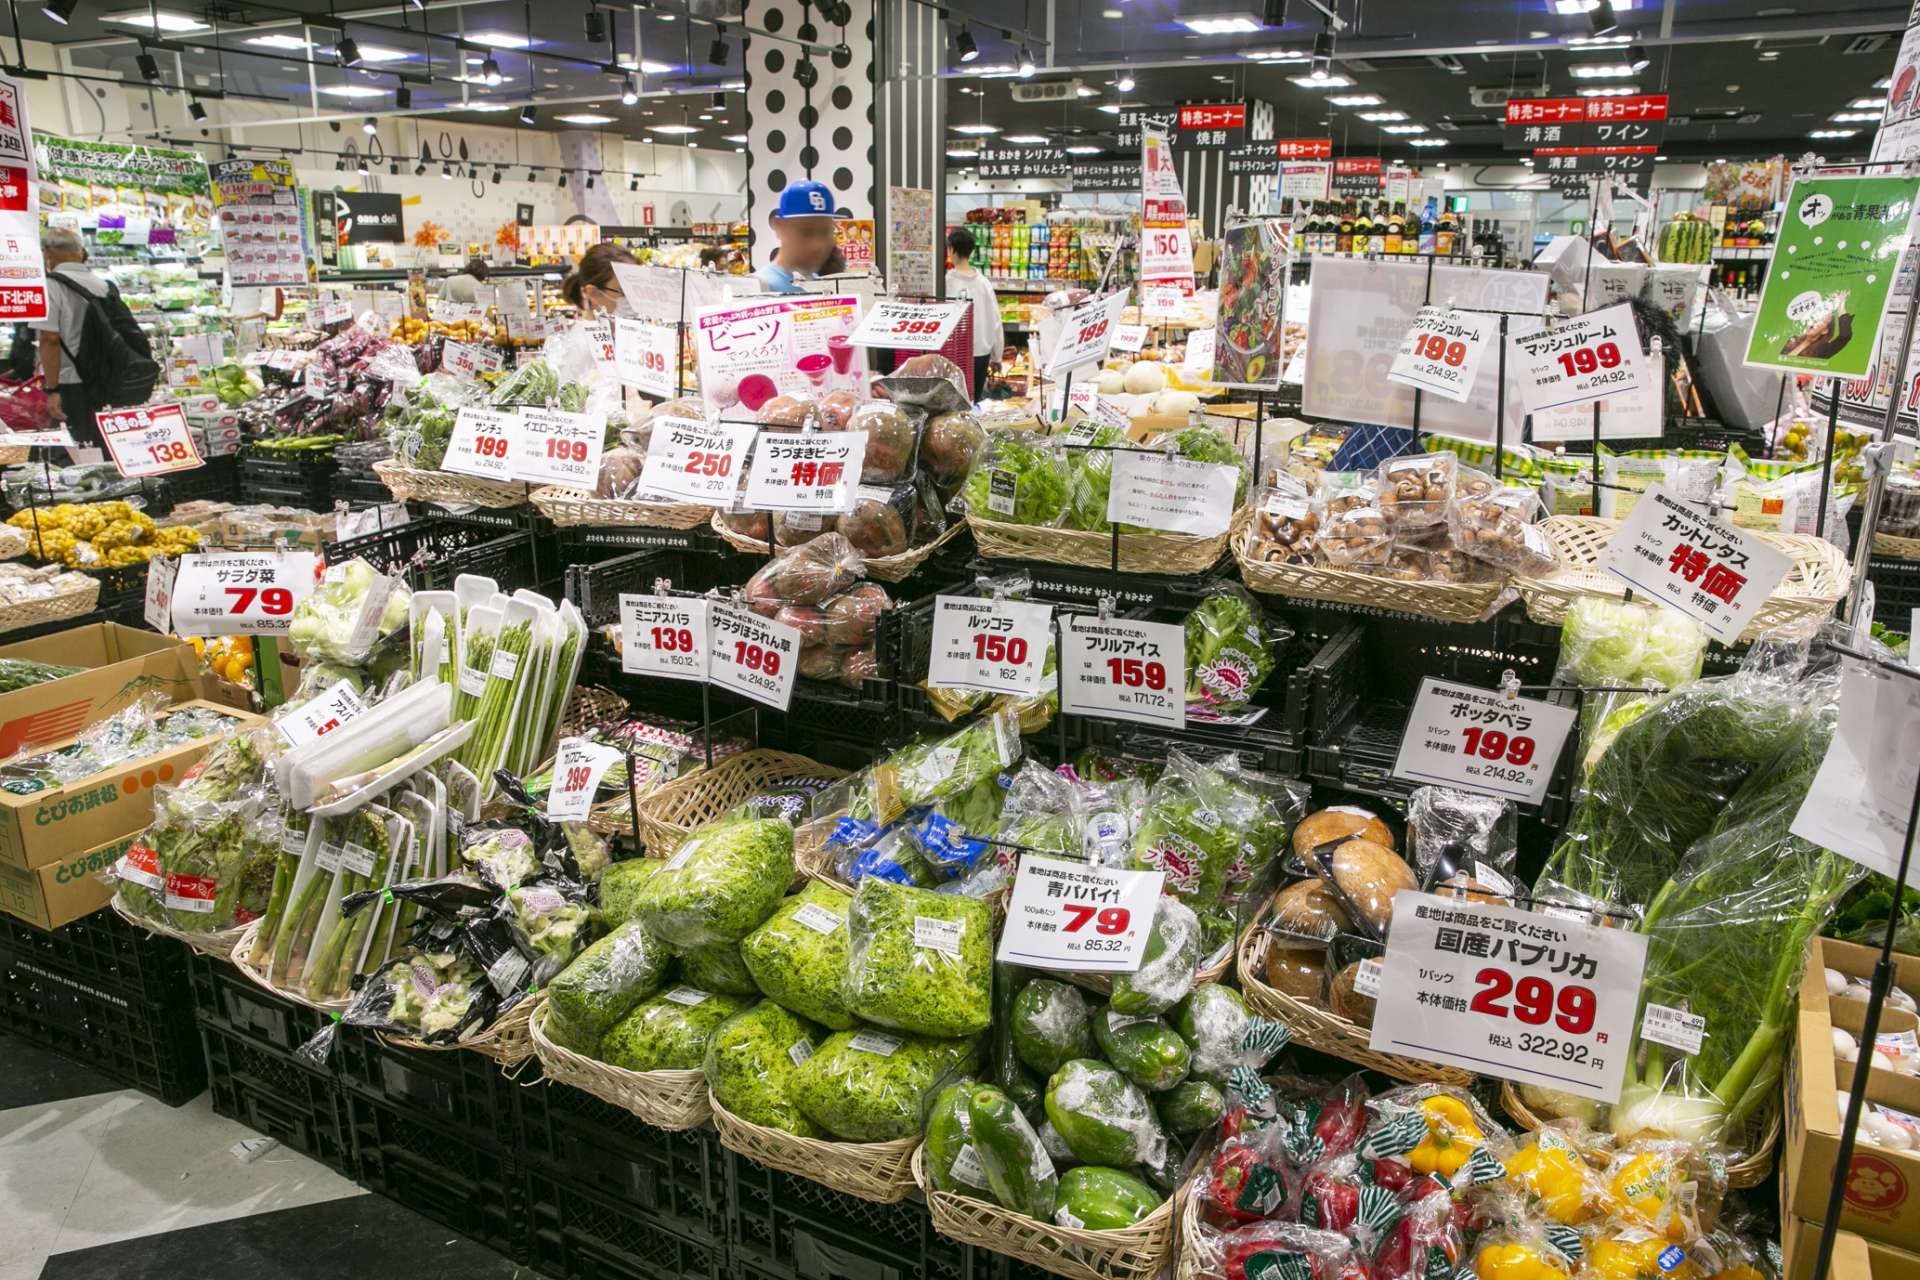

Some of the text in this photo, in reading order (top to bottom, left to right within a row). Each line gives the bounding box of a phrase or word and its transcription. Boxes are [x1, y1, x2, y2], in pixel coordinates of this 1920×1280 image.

[1181, 111, 1244, 125] 特売コーナー
[1508, 104, 1582, 120] 特売コーナー
[1587, 101, 1665, 118] 特売コーナー
[1524, 126, 1562, 142] 清酒
[1598, 124, 1649, 140] ワイン
[1024, 149, 1065, 160] シリアル
[1280, 143, 1329, 154] 特売コーナー
[1024, 165, 1066, 175] かりんとう
[1548, 156, 1577, 169] 清酒
[1604, 155, 1644, 168] ワイン
[707, 319, 781, 351] ビーツ
[891, 320, 941, 334] 399
[1077, 318, 1109, 345] 199
[1414, 333, 1467, 367] 199
[1524, 325, 1617, 357] マッシュルーム
[1556, 341, 1623, 378] 199
[1425, 364, 1458, 382] 214.92
[1589, 370, 1627, 389] 214.92
[102, 413, 153, 434] 広告の品
[475, 422, 503, 435] サンチュ
[475, 435, 508, 458] 199
[545, 437, 588, 463] 199
[670, 431, 734, 451] カラフル人参
[148, 441, 189, 465] 138
[684, 451, 732, 478] 250
[707, 480, 724, 491] 270
[790, 461, 845, 487] 特価
[1662, 513, 1750, 570] カットレタス
[216, 569, 276, 585] サラダ菜
[1633, 544, 1664, 567] 本体価格
[1668, 542, 1748, 606] 特価
[224, 587, 293, 615] 79
[1666, 581, 1682, 596] 税込
[1690, 591, 1719, 614] 特価
[635, 609, 690, 626] ミニアスパラ
[967, 614, 1014, 632] ルッコラ
[651, 626, 693, 653] 139
[711, 615, 792, 653] サラダほうれん草
[734, 640, 781, 677] 199
[946, 650, 971, 660] 本体価格
[973, 633, 1028, 665] 150
[1085, 636, 1161, 658] フリルアイス
[670, 655, 693, 667] 150.12
[748, 673, 776, 691] 214.92
[999, 667, 1017, 680] 162
[1079, 674, 1106, 685] 本体価格
[1107, 657, 1166, 691] 159
[1450, 703, 1532, 731] ポッタベラ
[1424, 740, 1456, 754] 本体価格
[1462, 726, 1536, 766] 199
[1465, 765, 1480, 776] 税込
[1482, 765, 1525, 785] 214.92
[34, 782, 119, 827] とぴあ浜松
[1026, 920, 1057, 932] 本体価格
[1061, 903, 1131, 936] 79
[1414, 904, 1568, 943] 産地は商品をご覧ください
[1084, 939, 1123, 952] 85.32
[1434, 926, 1599, 980] 国産パプリカ
[1416, 967, 1609, 1045] 本体価格 299 円
[1488, 1032, 1604, 1071] 税込 322.92 円
